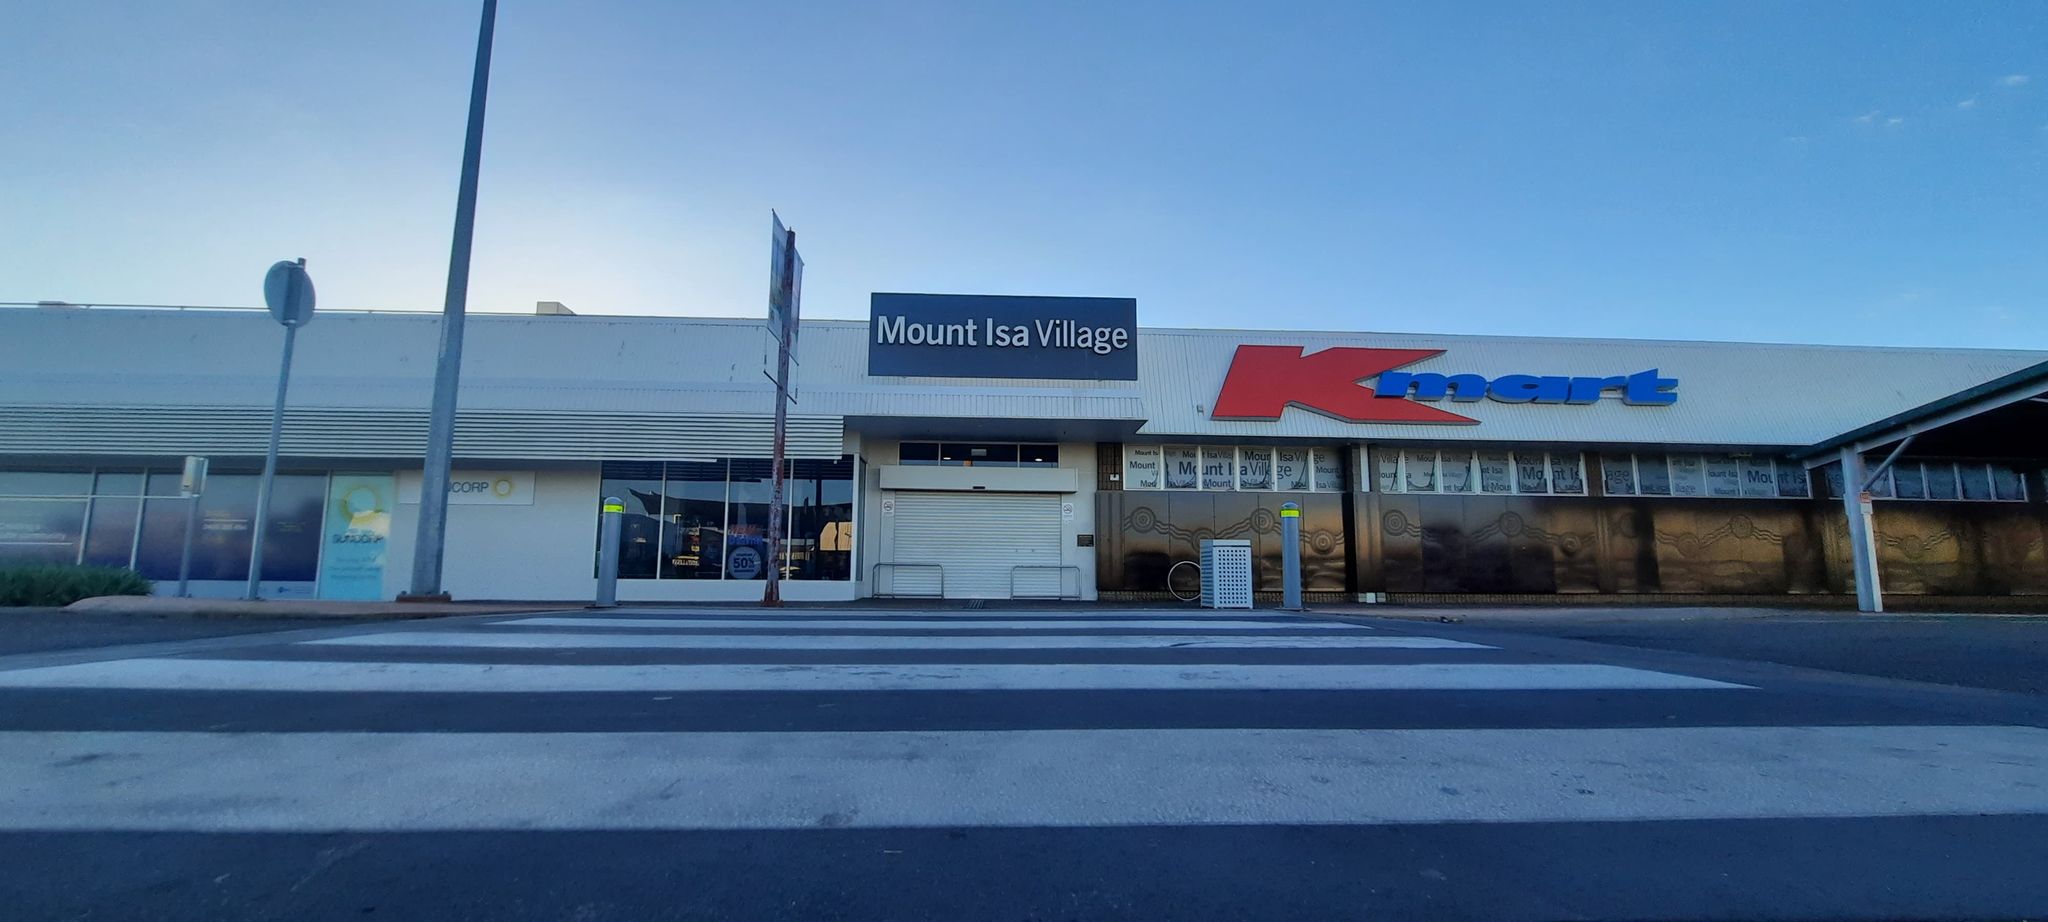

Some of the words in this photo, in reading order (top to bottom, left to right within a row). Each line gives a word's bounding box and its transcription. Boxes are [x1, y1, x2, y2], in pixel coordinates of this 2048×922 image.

[877, 315, 978, 346] Mount
[986, 318, 1030, 347] Isa
[1035, 319, 1128, 355] Village
[1210, 344, 1678, 425] Kmart
[1129, 460, 1156, 470] Mount
[1228, 462, 1248, 476] Ia
